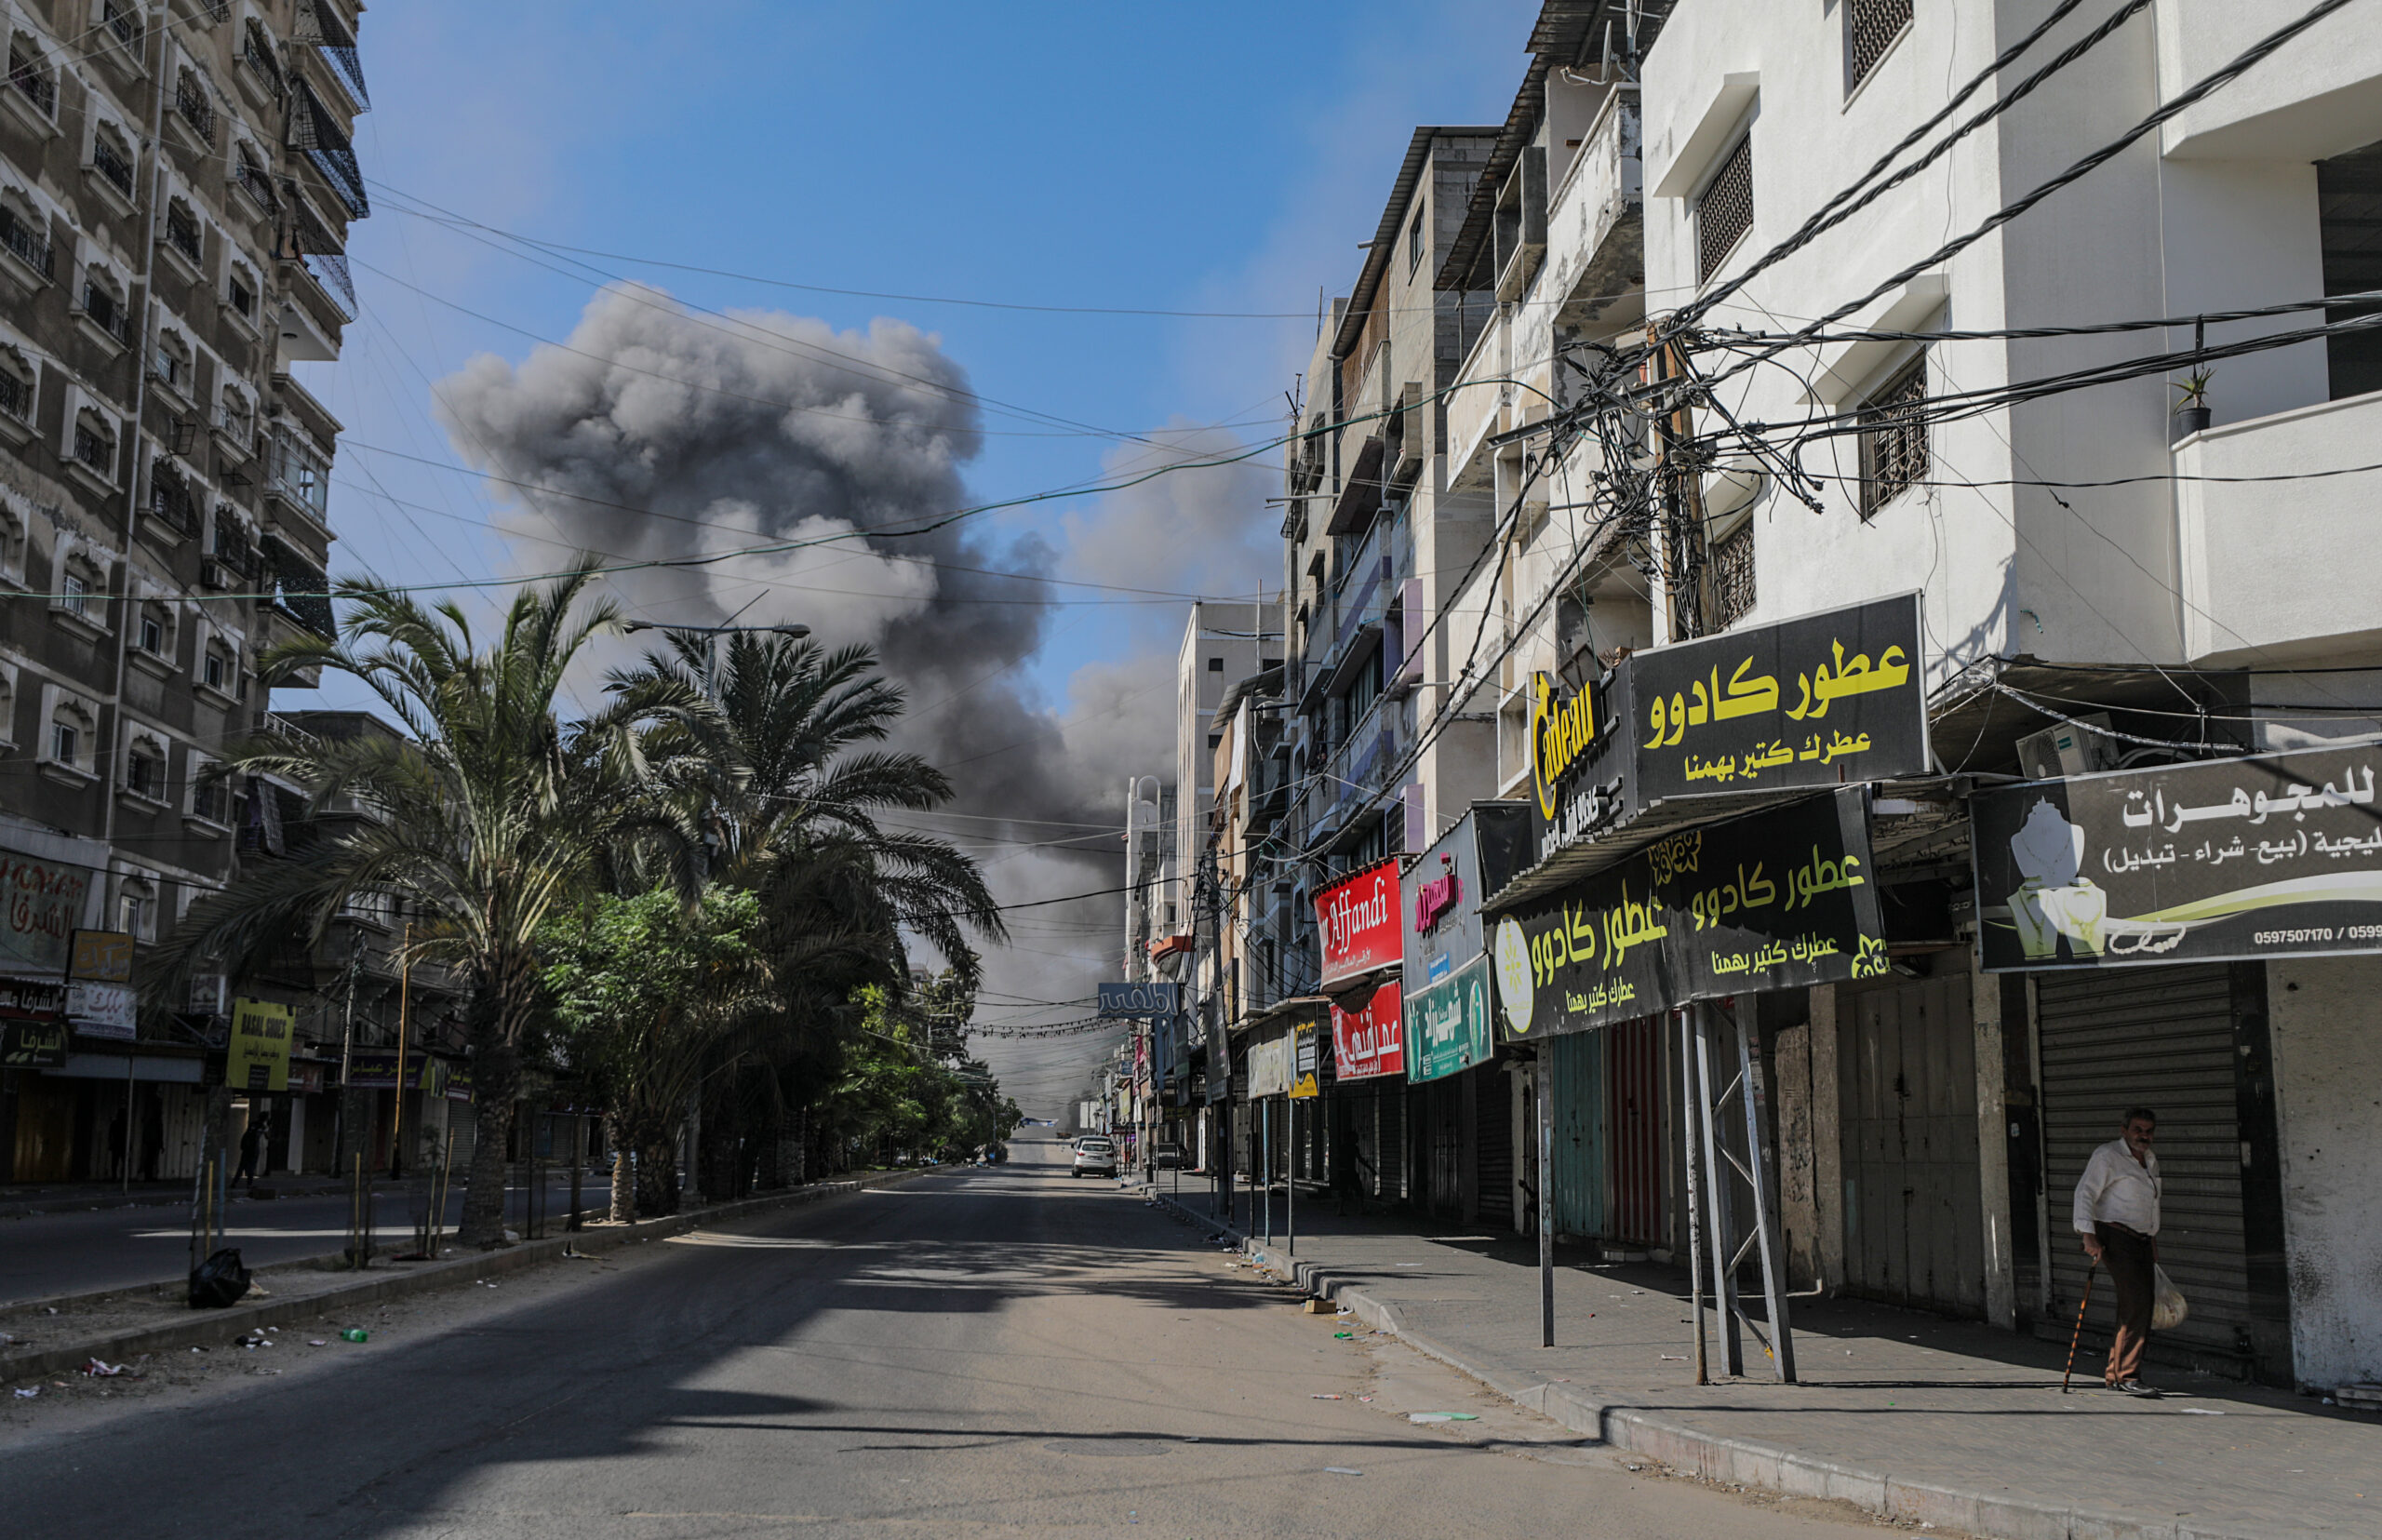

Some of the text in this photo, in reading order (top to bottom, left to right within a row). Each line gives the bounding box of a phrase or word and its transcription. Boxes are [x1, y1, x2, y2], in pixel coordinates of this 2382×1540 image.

[1643, 636, 1909, 749] عطور كادوو
[1533, 673, 1595, 821] Cadeau
[1684, 729, 1871, 783] عطرك كتير بهمنا
[2123, 764, 2375, 834] للمجوهرات
[2196, 835, 2244, 864] شراء
[2312, 825, 2382, 858] ليجية
[1692, 843, 1866, 931] عطور كادوو
[1330, 876, 1388, 957] Affandi
[1532, 879, 1668, 989] عطور كادوو
[2255, 928, 2333, 944] 0597507170
[1710, 931, 1840, 975] عطرك كتير بهمنا
[1565, 989, 1587, 1015] بهمنا
[1588, 982, 1608, 1014] كتير
[1609, 976, 1636, 1008] عطرك
